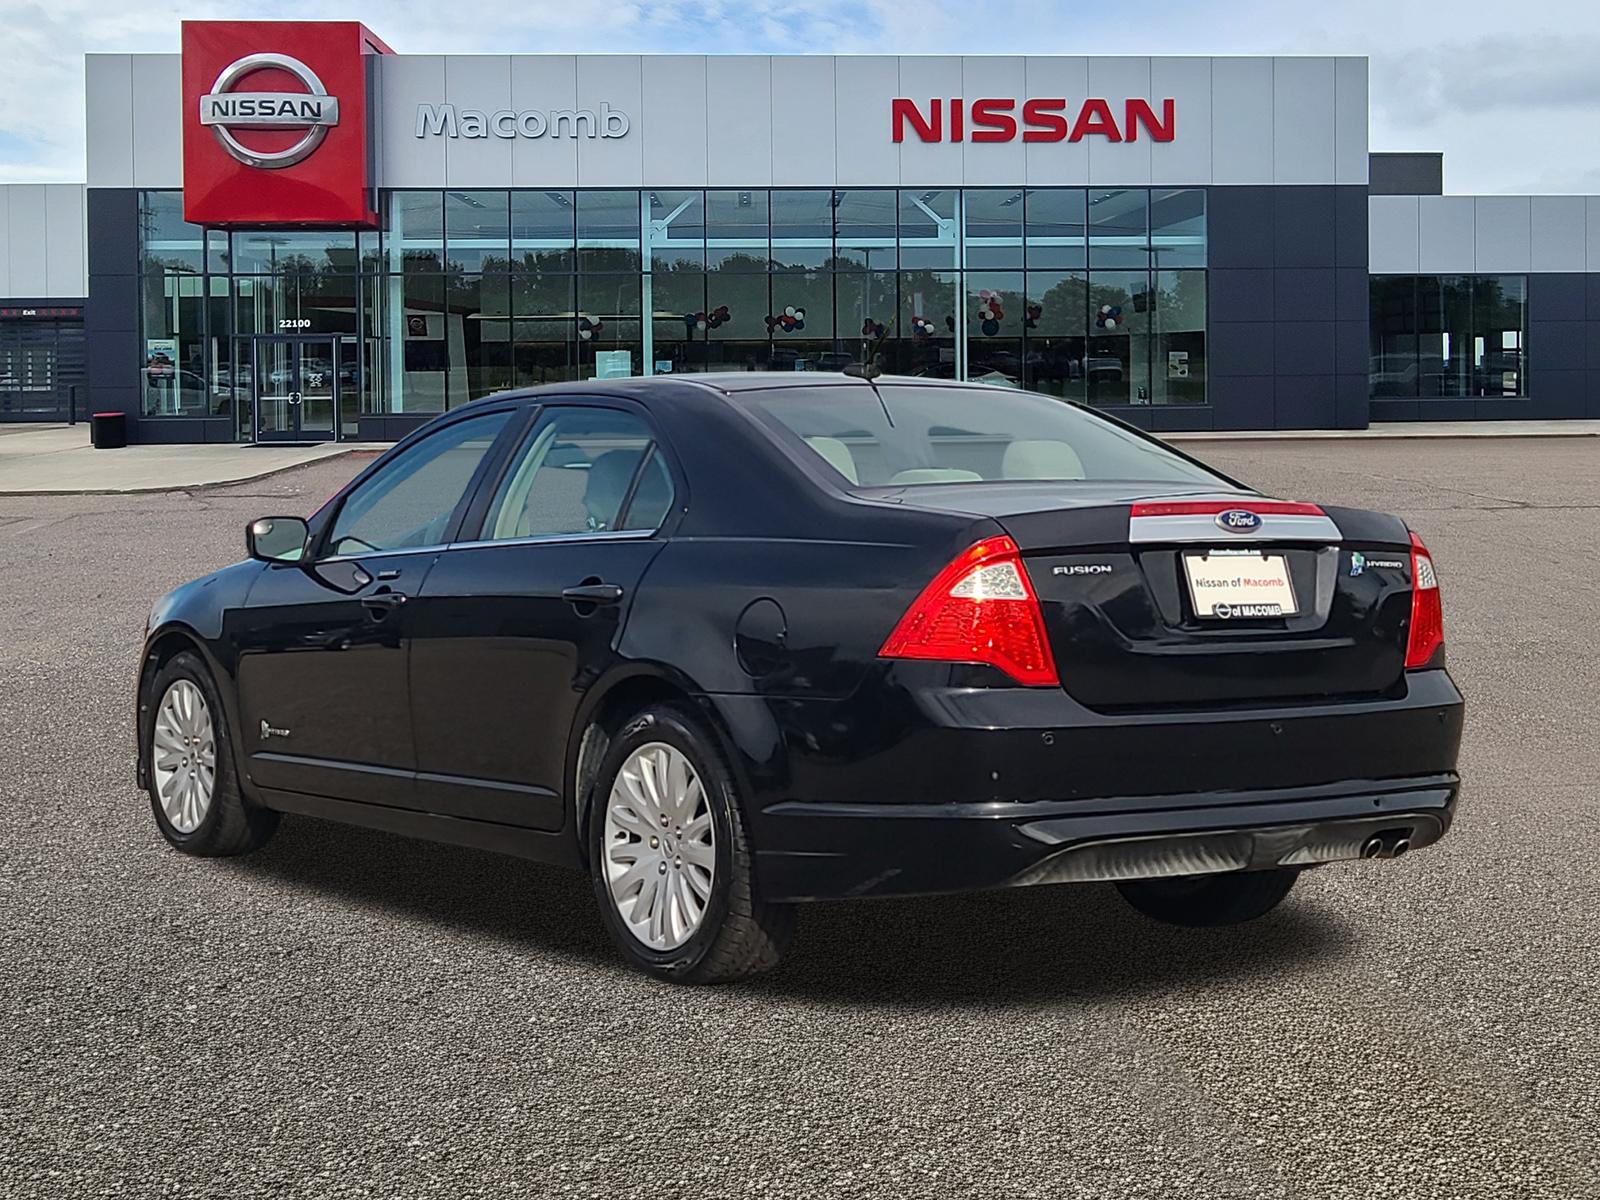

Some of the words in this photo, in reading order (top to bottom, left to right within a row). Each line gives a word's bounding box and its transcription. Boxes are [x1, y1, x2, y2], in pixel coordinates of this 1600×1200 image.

[211, 99, 322, 118] NISSAN
[415, 101, 630, 139] Macomb
[892, 98, 1175, 143] NISSAN
[279, 319, 311, 328] 22100
[1228, 511, 1255, 526] Ford
[1053, 565, 1112, 575] FUSION
[1195, 577, 1229, 588] Nissan
[1231, 577, 1241, 588] of
[1243, 577, 1285, 588] Macomb
[1232, 605, 1241, 617] of
[1242, 605, 1282, 616] MACOMB
